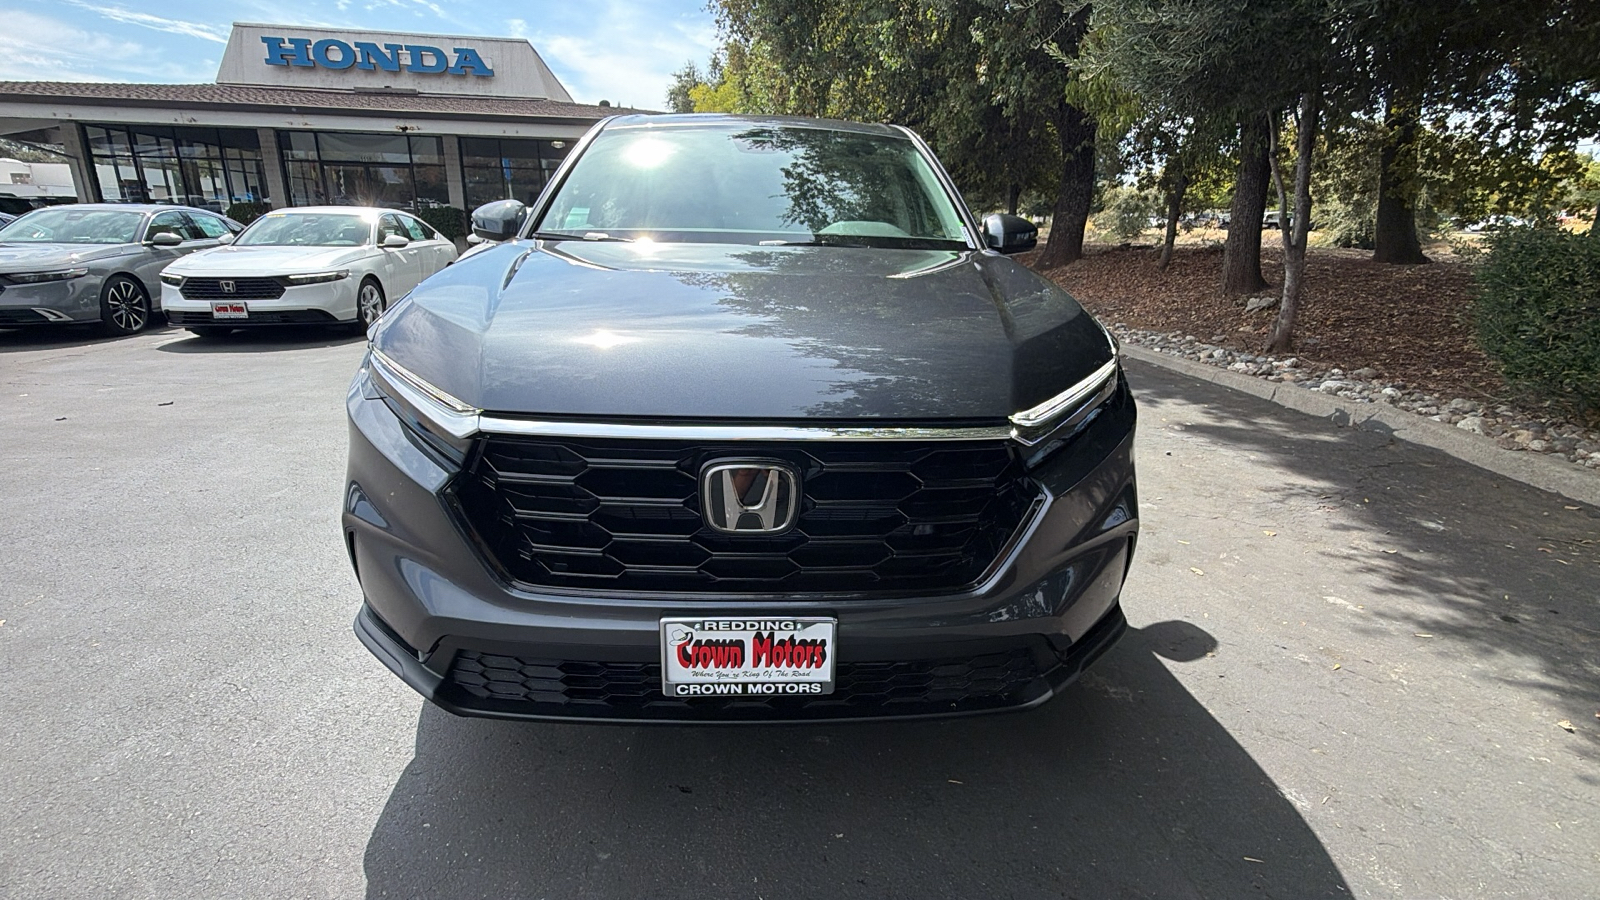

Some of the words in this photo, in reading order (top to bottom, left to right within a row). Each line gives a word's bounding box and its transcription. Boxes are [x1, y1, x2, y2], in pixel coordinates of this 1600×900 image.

[261, 36, 494, 77] HONDA
[704, 621, 795, 631] REDDING
[676, 632, 745, 669] Crown
[752, 632, 826, 669] Motors
[691, 670, 714, 678] Where
[715, 671, 740, 680] You're
[742, 670, 760, 678] King
[763, 670, 773, 678] Of
[676, 683, 742, 695] CROWN
[747, 683, 822, 694] MOTORS
